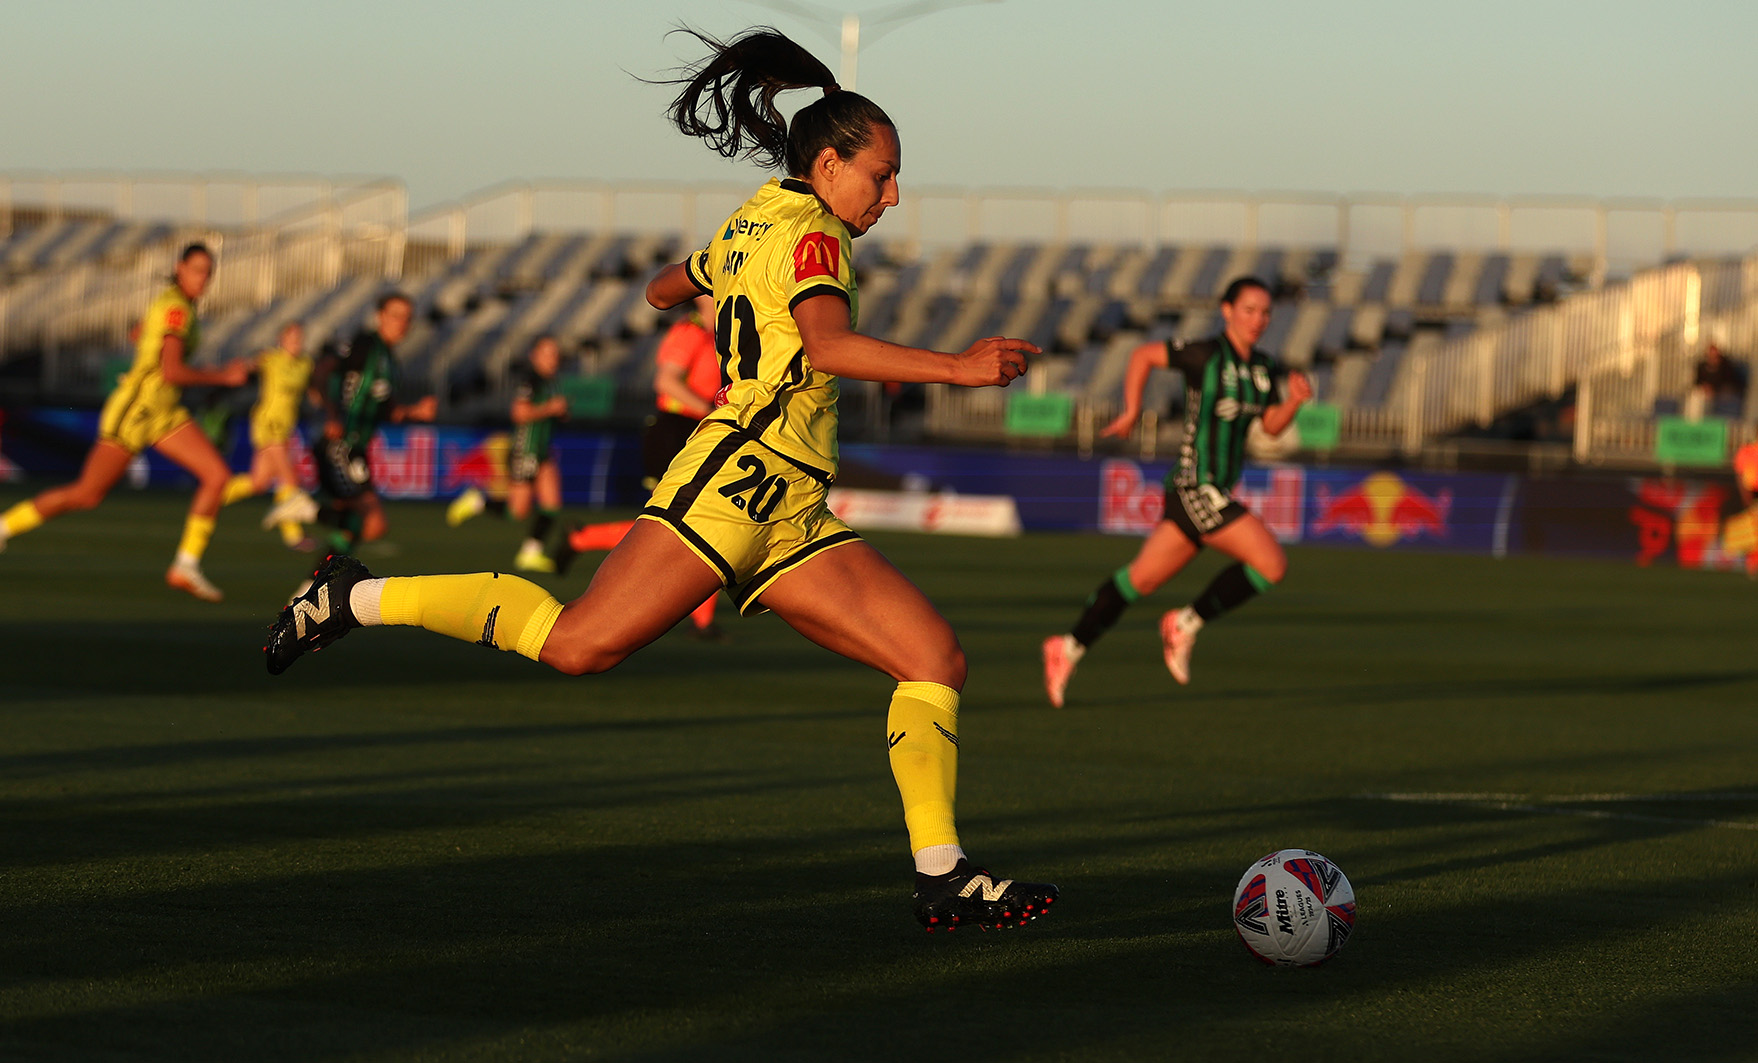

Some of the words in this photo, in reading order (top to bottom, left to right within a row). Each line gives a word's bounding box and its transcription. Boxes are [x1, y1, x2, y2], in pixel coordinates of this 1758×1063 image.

[718, 454, 788, 523] 20
[1275, 889, 1295, 936] Mitre
[1295, 889, 1307, 920] LEAGUES
